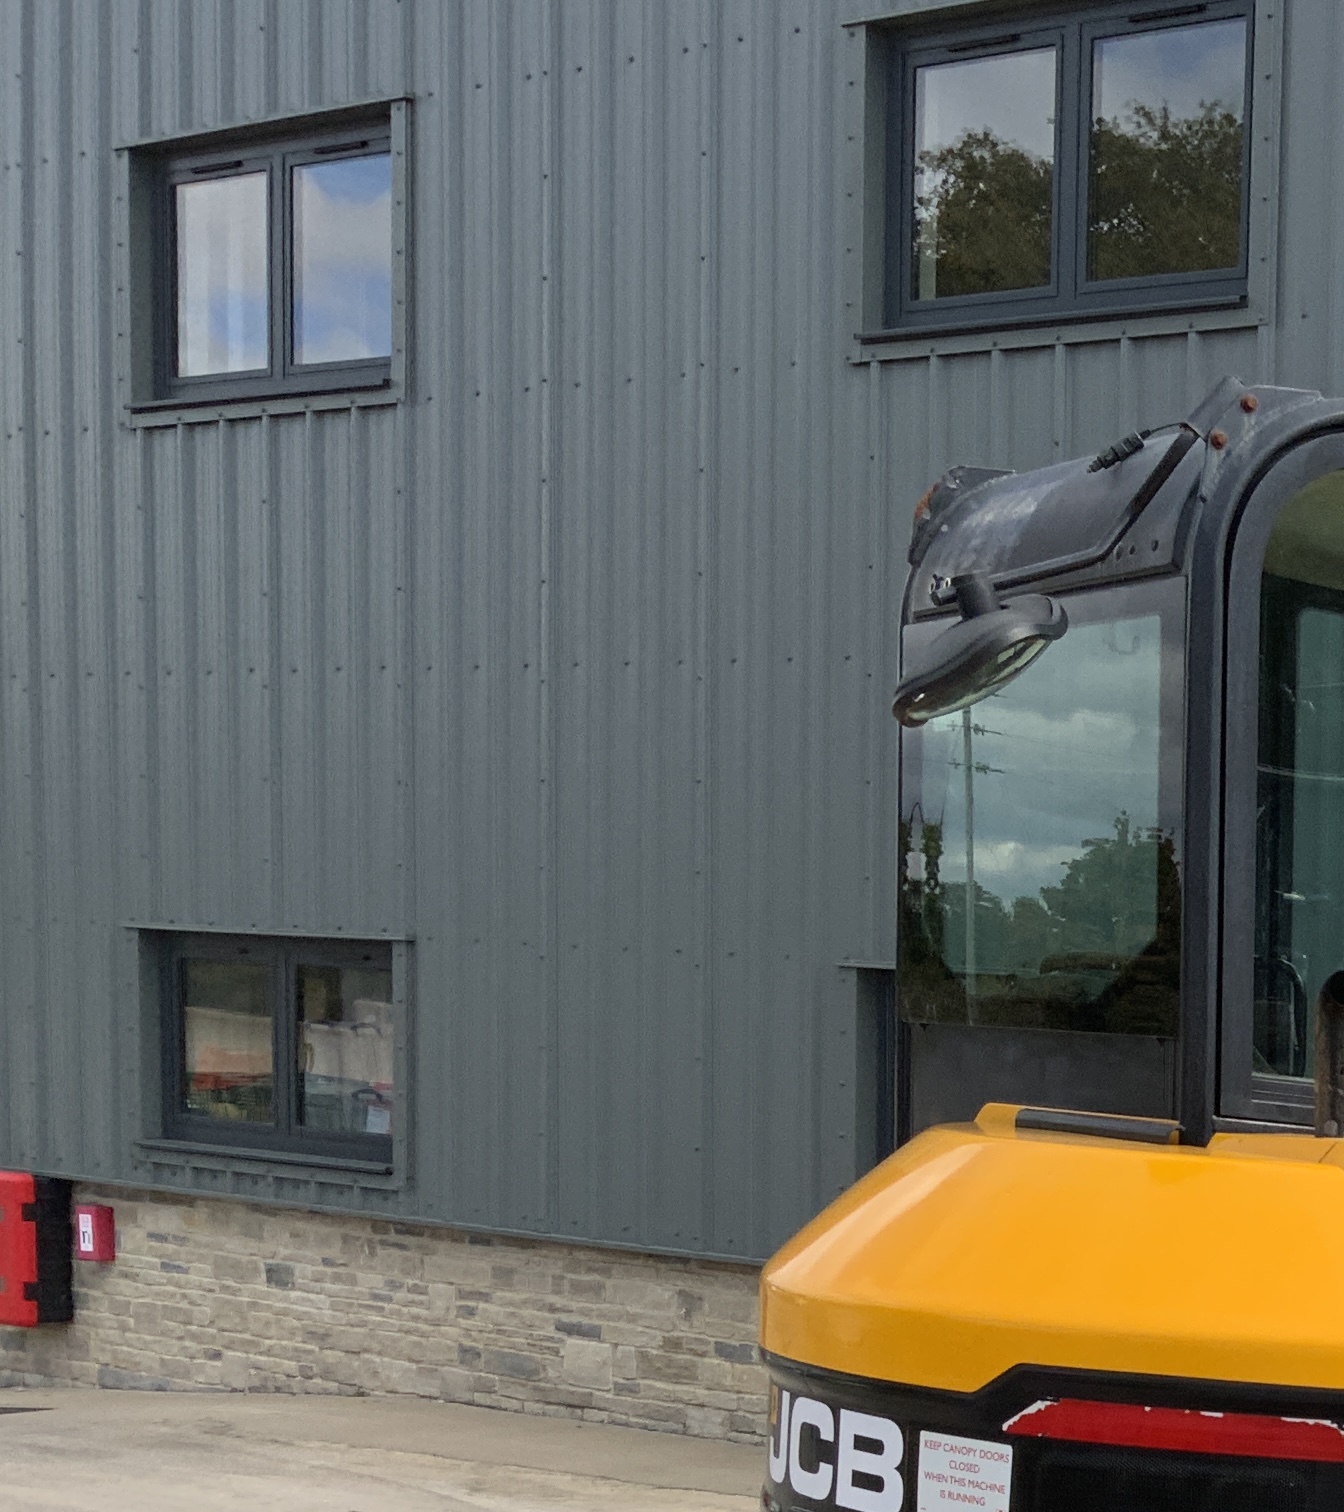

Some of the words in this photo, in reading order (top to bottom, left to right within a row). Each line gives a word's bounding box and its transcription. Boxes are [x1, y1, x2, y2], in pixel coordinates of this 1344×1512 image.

[924, 1439, 942, 1451] KEEP
[943, 1443, 978, 1457] CANOPY
[979, 1449, 1010, 1463] DOORS
[949, 1459, 980, 1474] CLOSED
[924, 1471, 948, 1484] WHEN
[949, 1475, 966, 1487] THIS
[967, 1479, 1006, 1494] MACHINE
[939, 1489, 946, 1499] IS
[947, 1490, 986, 1506] RUNNING
